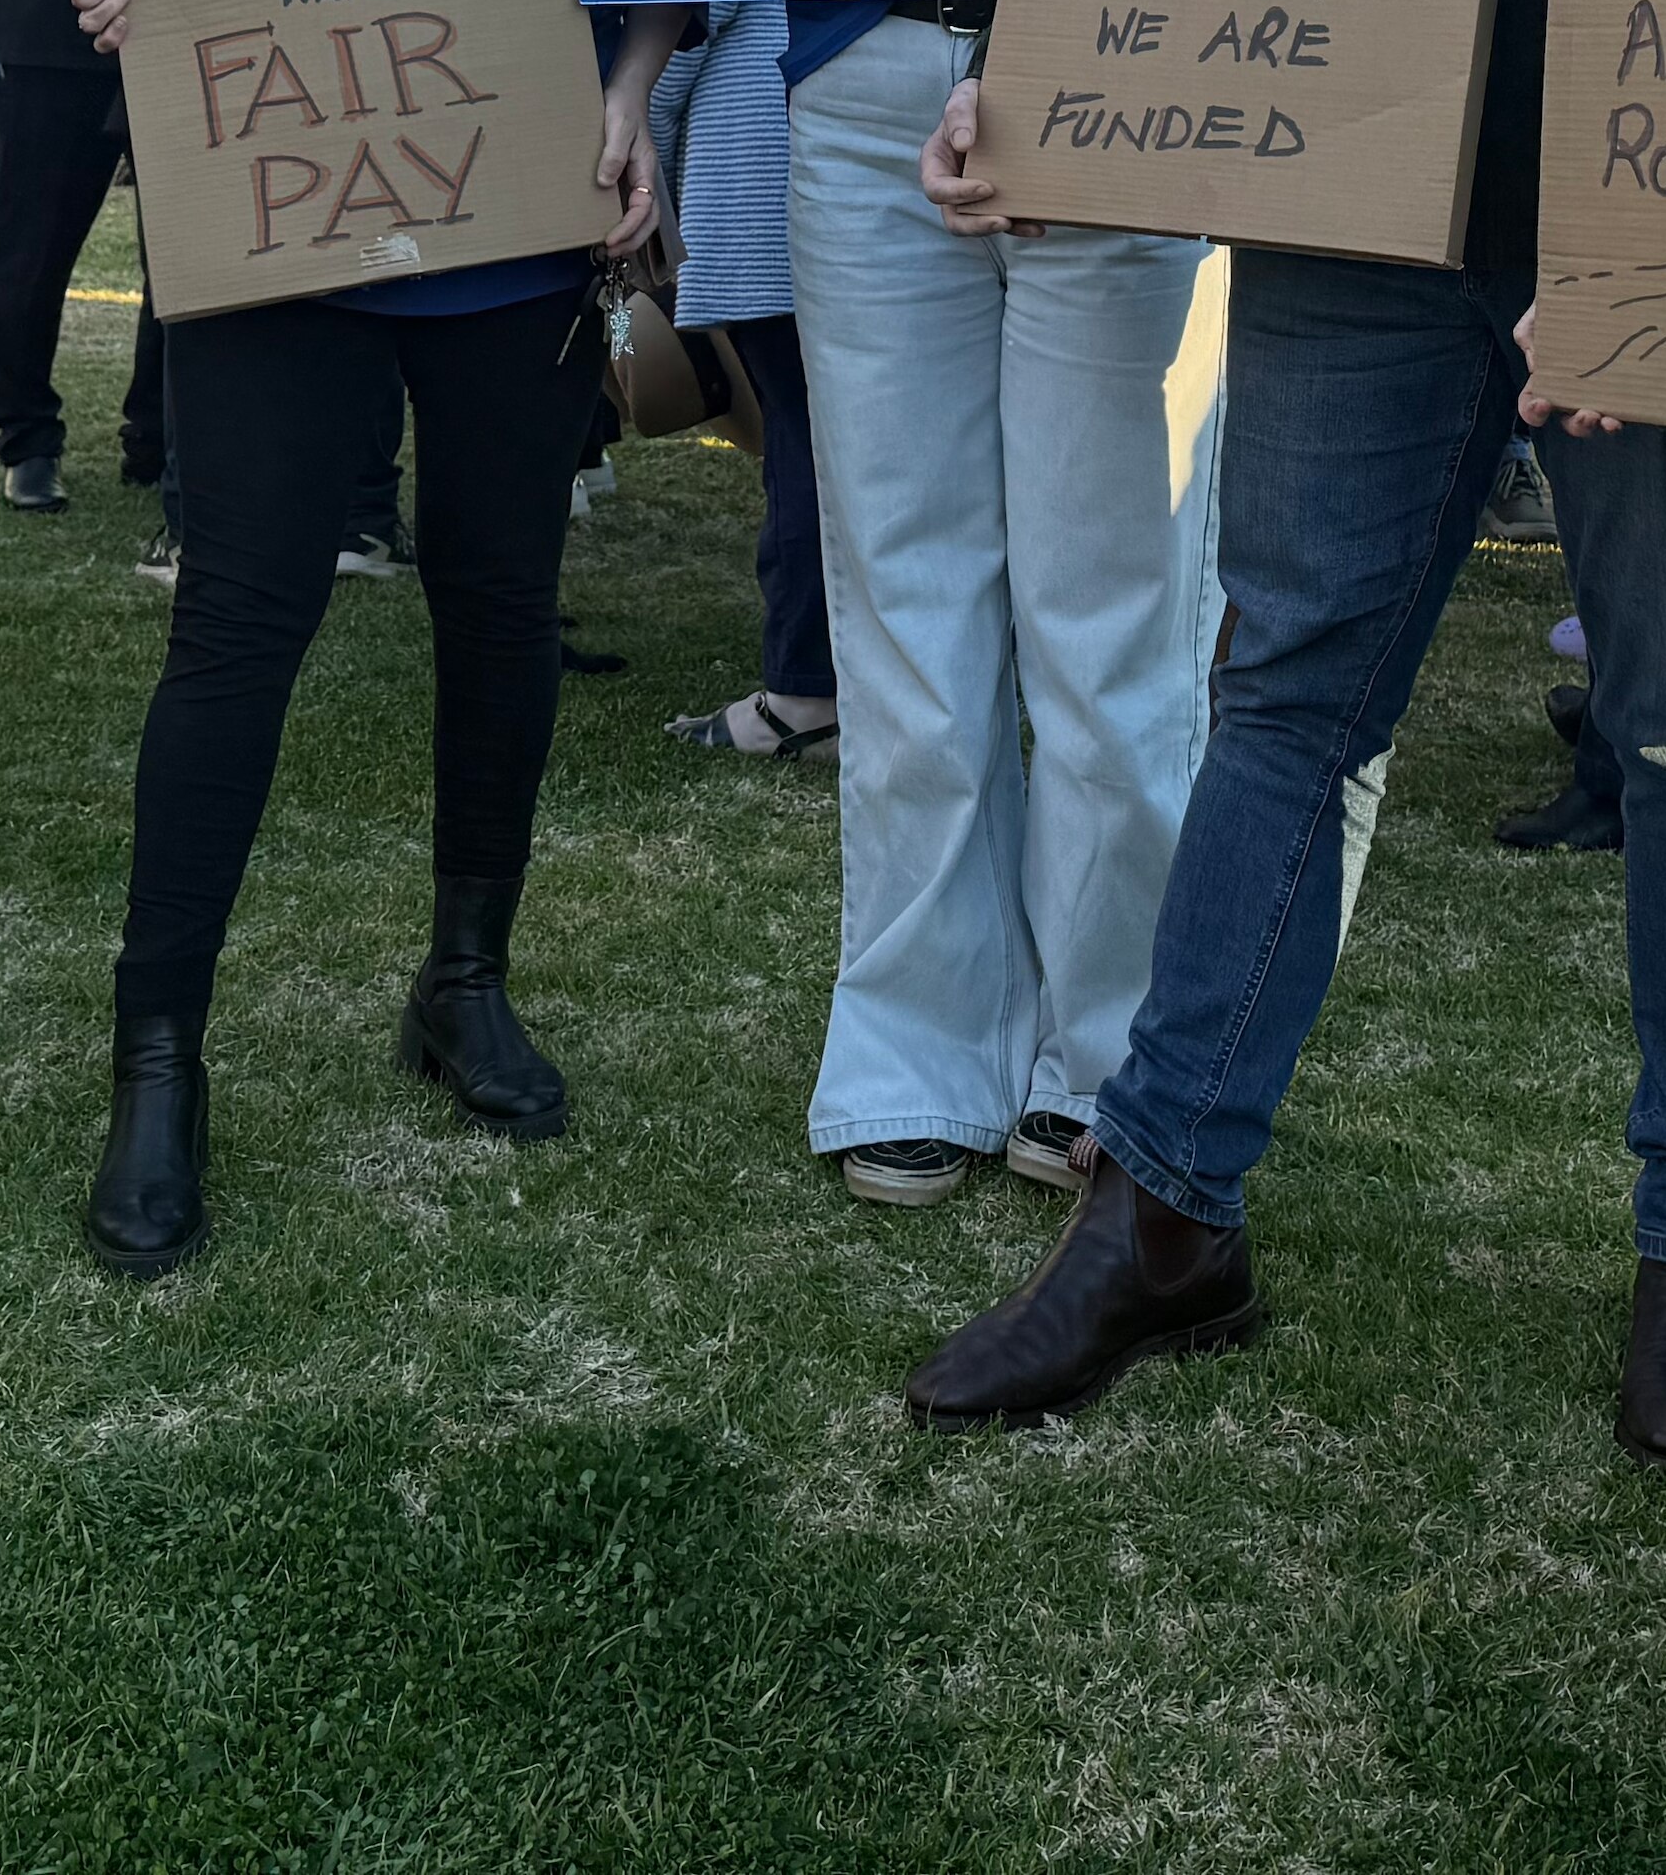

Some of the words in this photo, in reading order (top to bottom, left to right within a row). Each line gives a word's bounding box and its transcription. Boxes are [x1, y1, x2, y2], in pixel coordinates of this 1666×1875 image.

[193, 10, 500, 150] FAIR
[1094, 6, 1169, 57] WE
[1197, 5, 1331, 68] ARE
[1037, 90, 1308, 158] FUNDED
[246, 124, 486, 257] PAY
